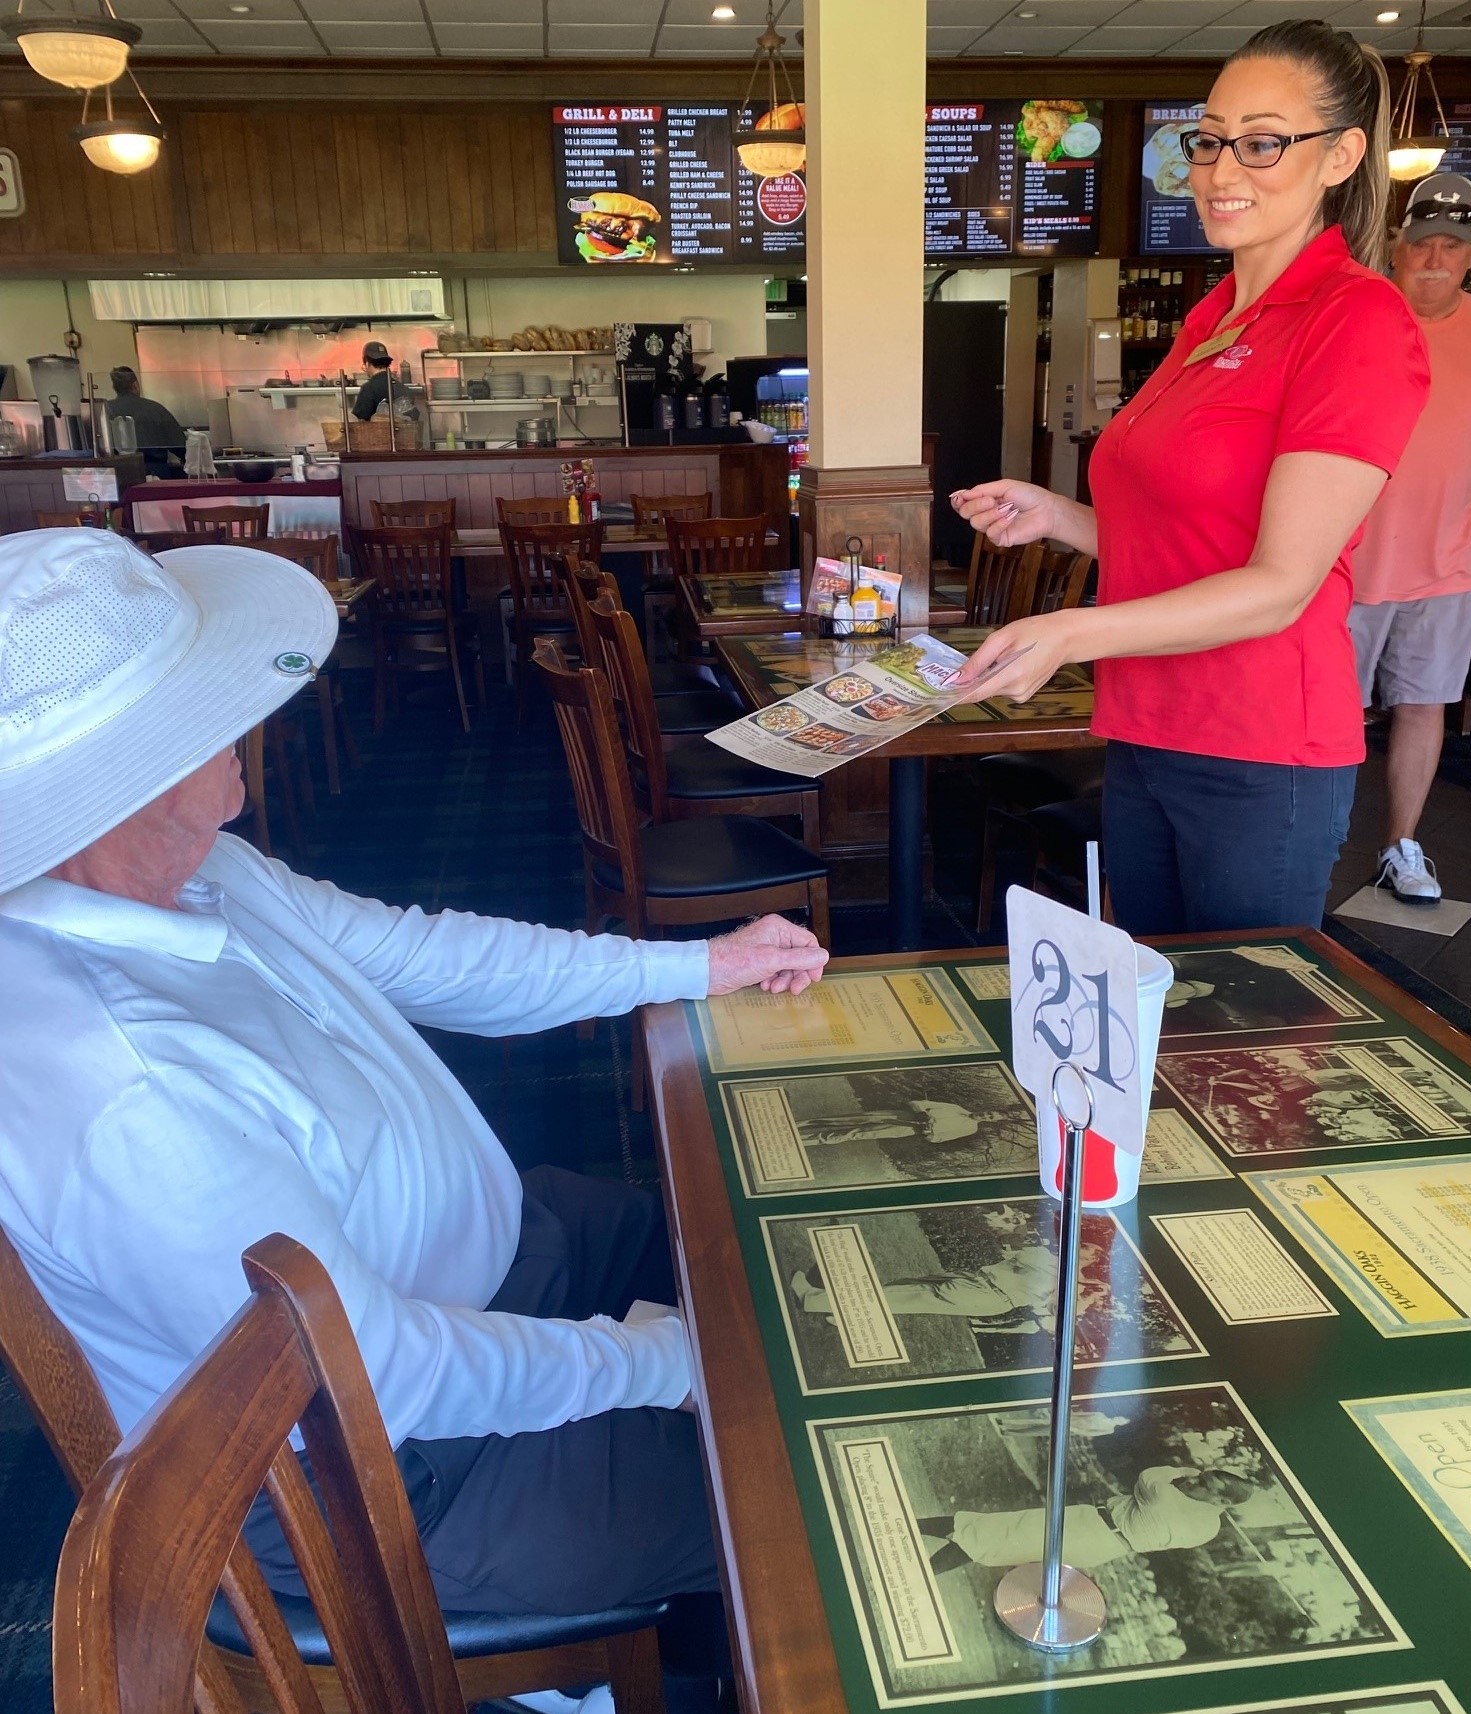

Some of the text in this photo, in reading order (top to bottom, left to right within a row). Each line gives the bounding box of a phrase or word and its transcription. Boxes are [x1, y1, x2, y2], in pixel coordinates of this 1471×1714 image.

[563, 109, 653, 120] GRILL & DELI
[932, 108, 976, 119] SOUPS
[1153, 109, 1205, 120] BREAKF
[1032, 938, 1126, 1093] 21
[1356, 1183, 1381, 1207] Open
[1378, 1204, 1429, 1255] Sacramento
[1427, 1255, 1455, 1276] 1938
[1353, 1250, 1417, 1310] HAGGIN OAKS
[1418, 1432, 1471, 1489] Open
